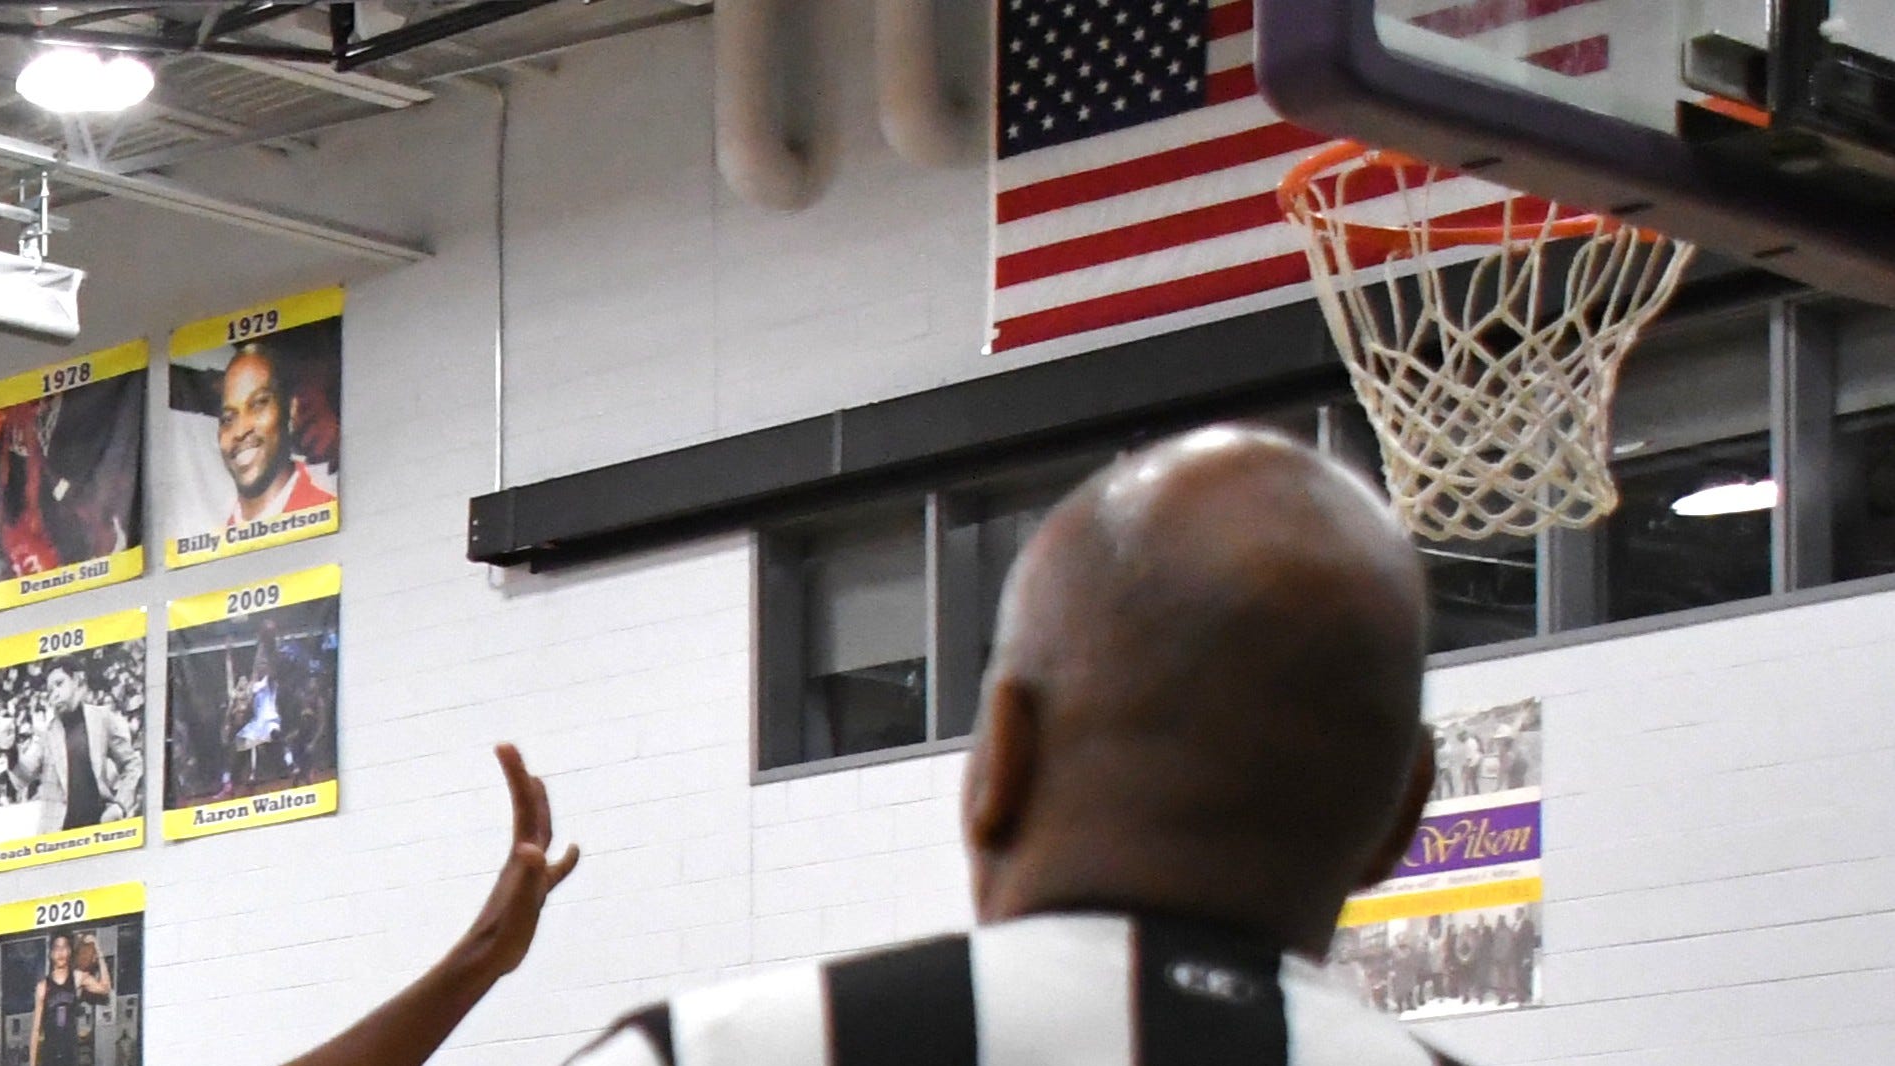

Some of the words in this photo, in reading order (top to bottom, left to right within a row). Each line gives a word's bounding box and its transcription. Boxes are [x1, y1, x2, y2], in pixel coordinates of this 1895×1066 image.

[227, 310, 279, 341] 1979
[42, 363, 91, 393] 1978
[176, 533, 221, 558] Billy
[224, 507, 331, 544] Culbertson
[20, 570, 75, 595] Dennis
[78, 560, 110, 582] Still
[227, 585, 281, 614] 2009
[38, 629, 84, 654] 2008
[193, 801, 249, 826] Aaron
[252, 789, 316, 817] Walton
[34, 832, 93, 855] Clarence
[94, 825, 137, 847] Turner
[1404, 817, 1532, 868] Wilson
[35, 900, 85, 925] 2020
